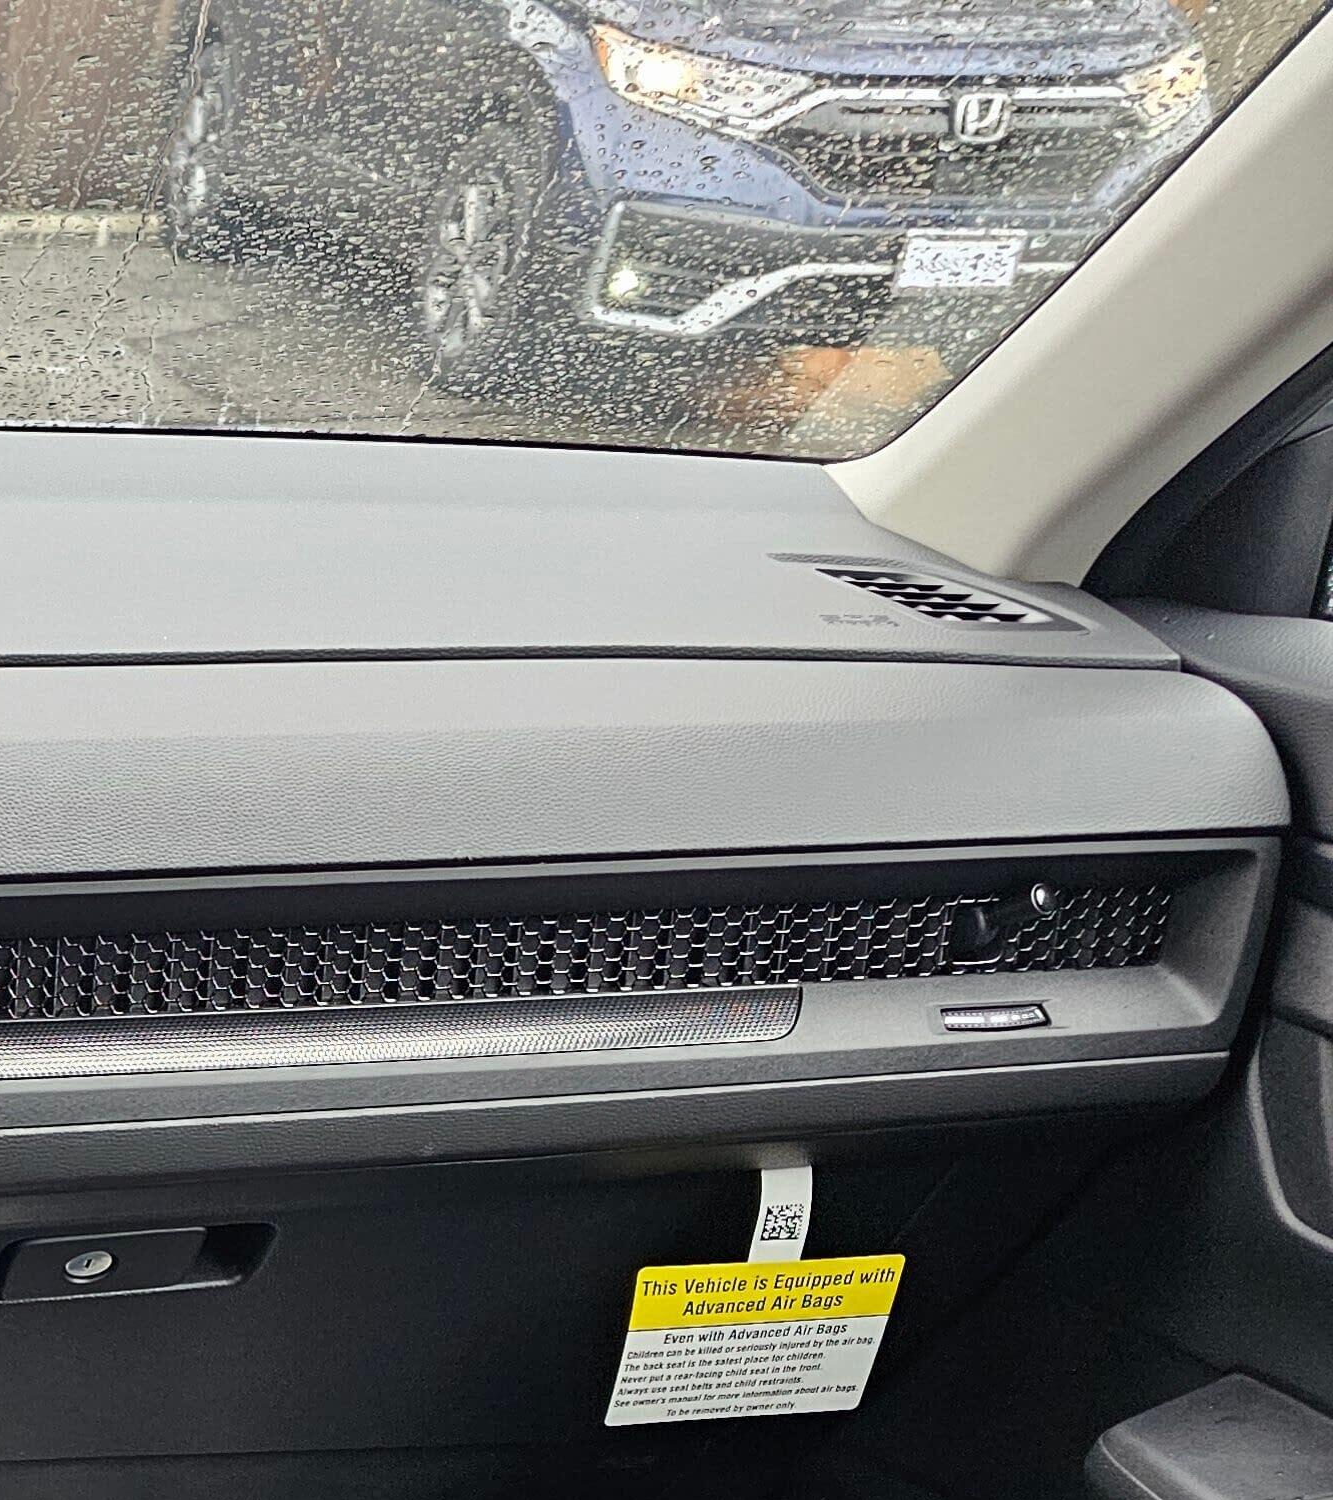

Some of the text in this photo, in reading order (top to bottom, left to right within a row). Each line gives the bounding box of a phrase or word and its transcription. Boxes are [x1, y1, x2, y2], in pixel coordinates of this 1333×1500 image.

[642, 1267, 895, 1297] This Vehicle is Equipped with
[683, 1293, 843, 1316] Advanced Air Bags
[663, 1323, 848, 1345] Even with Advanced Air Bags
[627, 1350, 664, 1360] Children
[666, 1350, 683, 1358] can
[684, 1348, 695, 1356] be
[697, 1345, 723, 1355] killed
[736, 1342, 777, 1352] seriously
[779, 1340, 810, 1351] injured
[812, 1339, 823, 1349] by
[825, 1338, 840, 1346] the
[841, 1337, 854, 1345] air
[620, 1375, 647, 1384] Never
[649, 1374, 664, 1384] put
[725, 1367, 748, 1377] child
[749, 1366, 769, 1375] seat
[771, 1365, 781, 1373] in
[782, 1365, 797, 1373] the
[624, 1364, 641, 1372] The
[643, 1362, 663, 1371] back
[666, 1360, 685, 1369] seat
[687, 1360, 696, 1368] is
[698, 1358, 713, 1367] the
[744, 1355, 769, 1365] place
[613, 1400, 630, 1408] See
[742, 1388, 792, 1398] information
[820, 1385, 834, 1393] air
[617, 1386, 648, 1396] Always
[691, 1382, 713, 1391] belts
[715, 1380, 732, 1389] and
[734, 1378, 756, 1388] child
[678, 1407, 690, 1416] be
[693, 1404, 731, 1414] removed
[733, 1403, 744, 1413] by
[746, 1403, 774, 1411] owner
